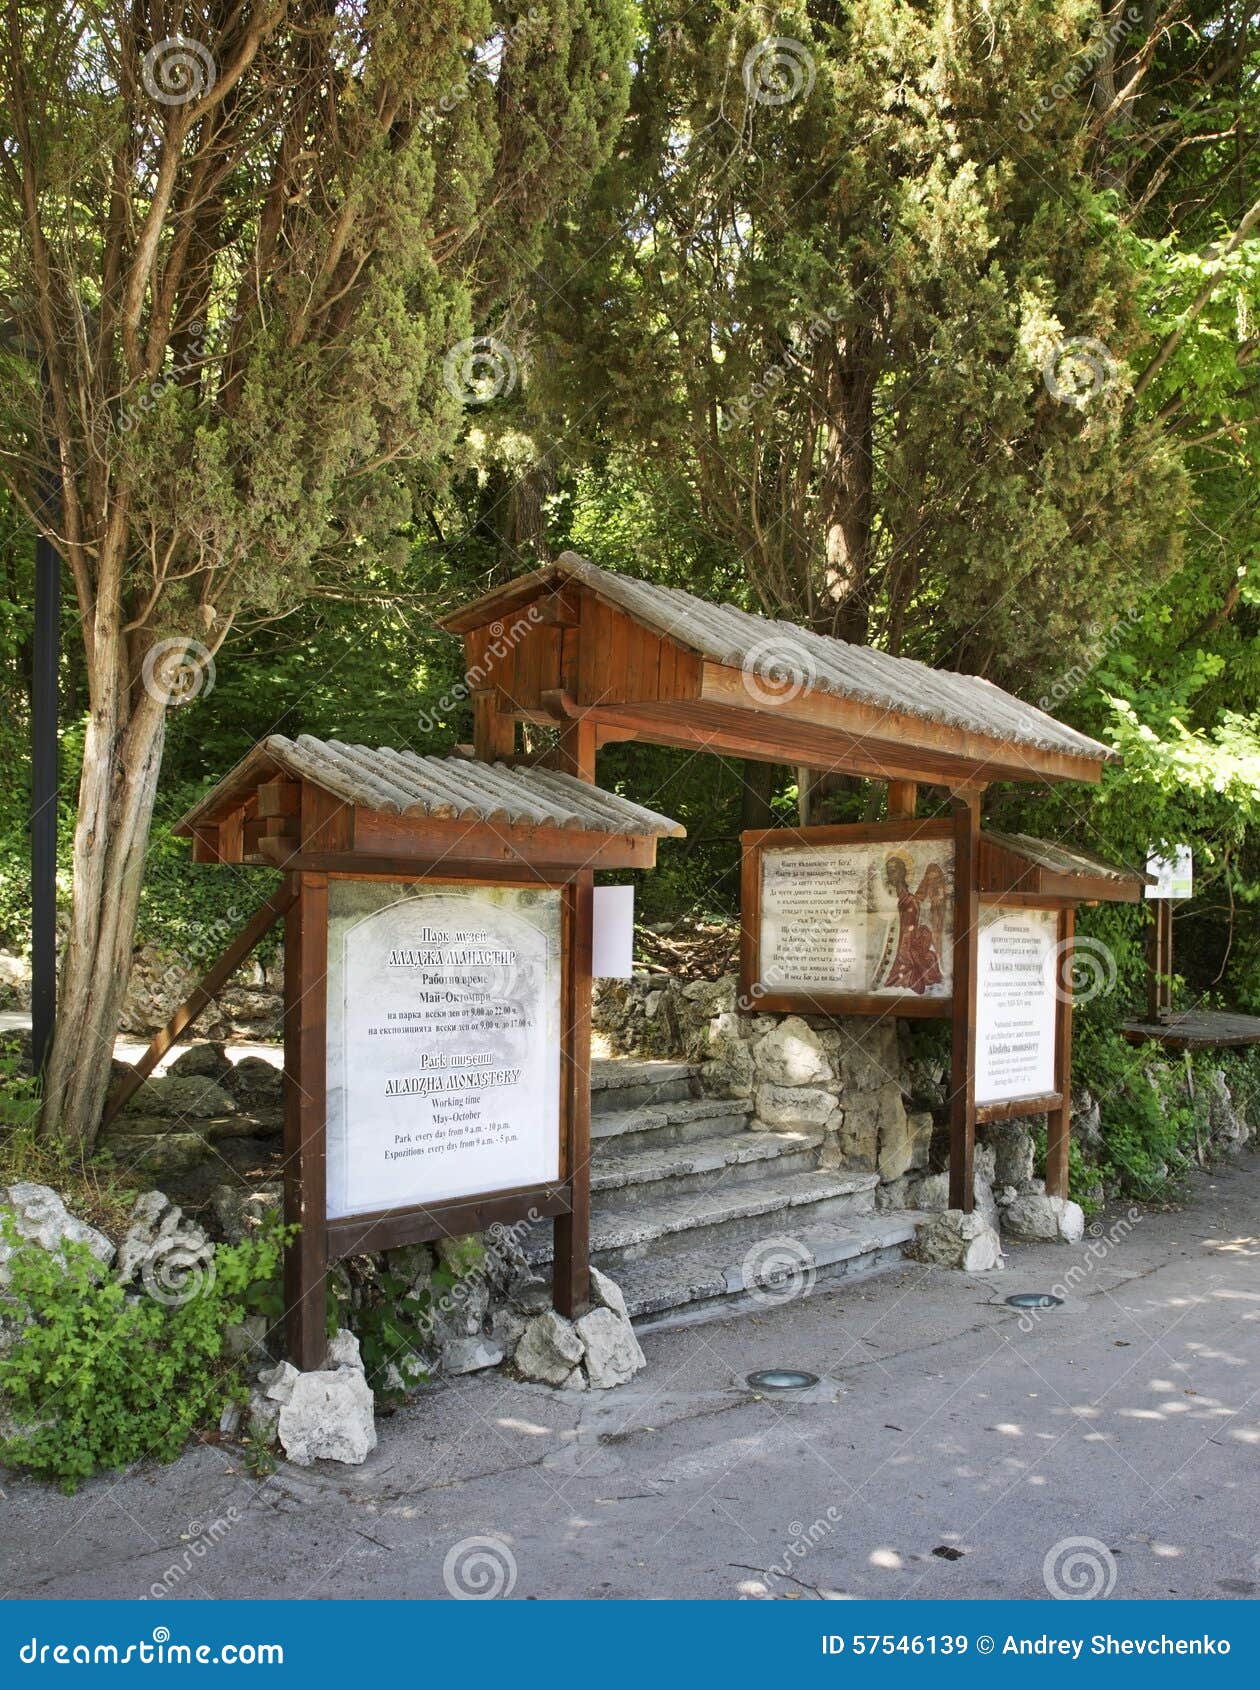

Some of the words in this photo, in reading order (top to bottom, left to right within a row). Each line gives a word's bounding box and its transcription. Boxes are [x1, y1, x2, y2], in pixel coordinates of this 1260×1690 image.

[423, 928, 449, 944] Парк
[422, 973, 460, 985] Работно
[398, 1011, 422, 1021] парка
[420, 1053, 447, 1069] Park
[451, 1052, 493, 1067] museum
[446, 1069, 522, 1091] MONASTERY
[432, 1097, 464, 1109] Working
[465, 1094, 481, 1105] time
[394, 1133, 413, 1145] Park
[415, 1132, 433, 1143] every
[427, 1143, 445, 1155] every
